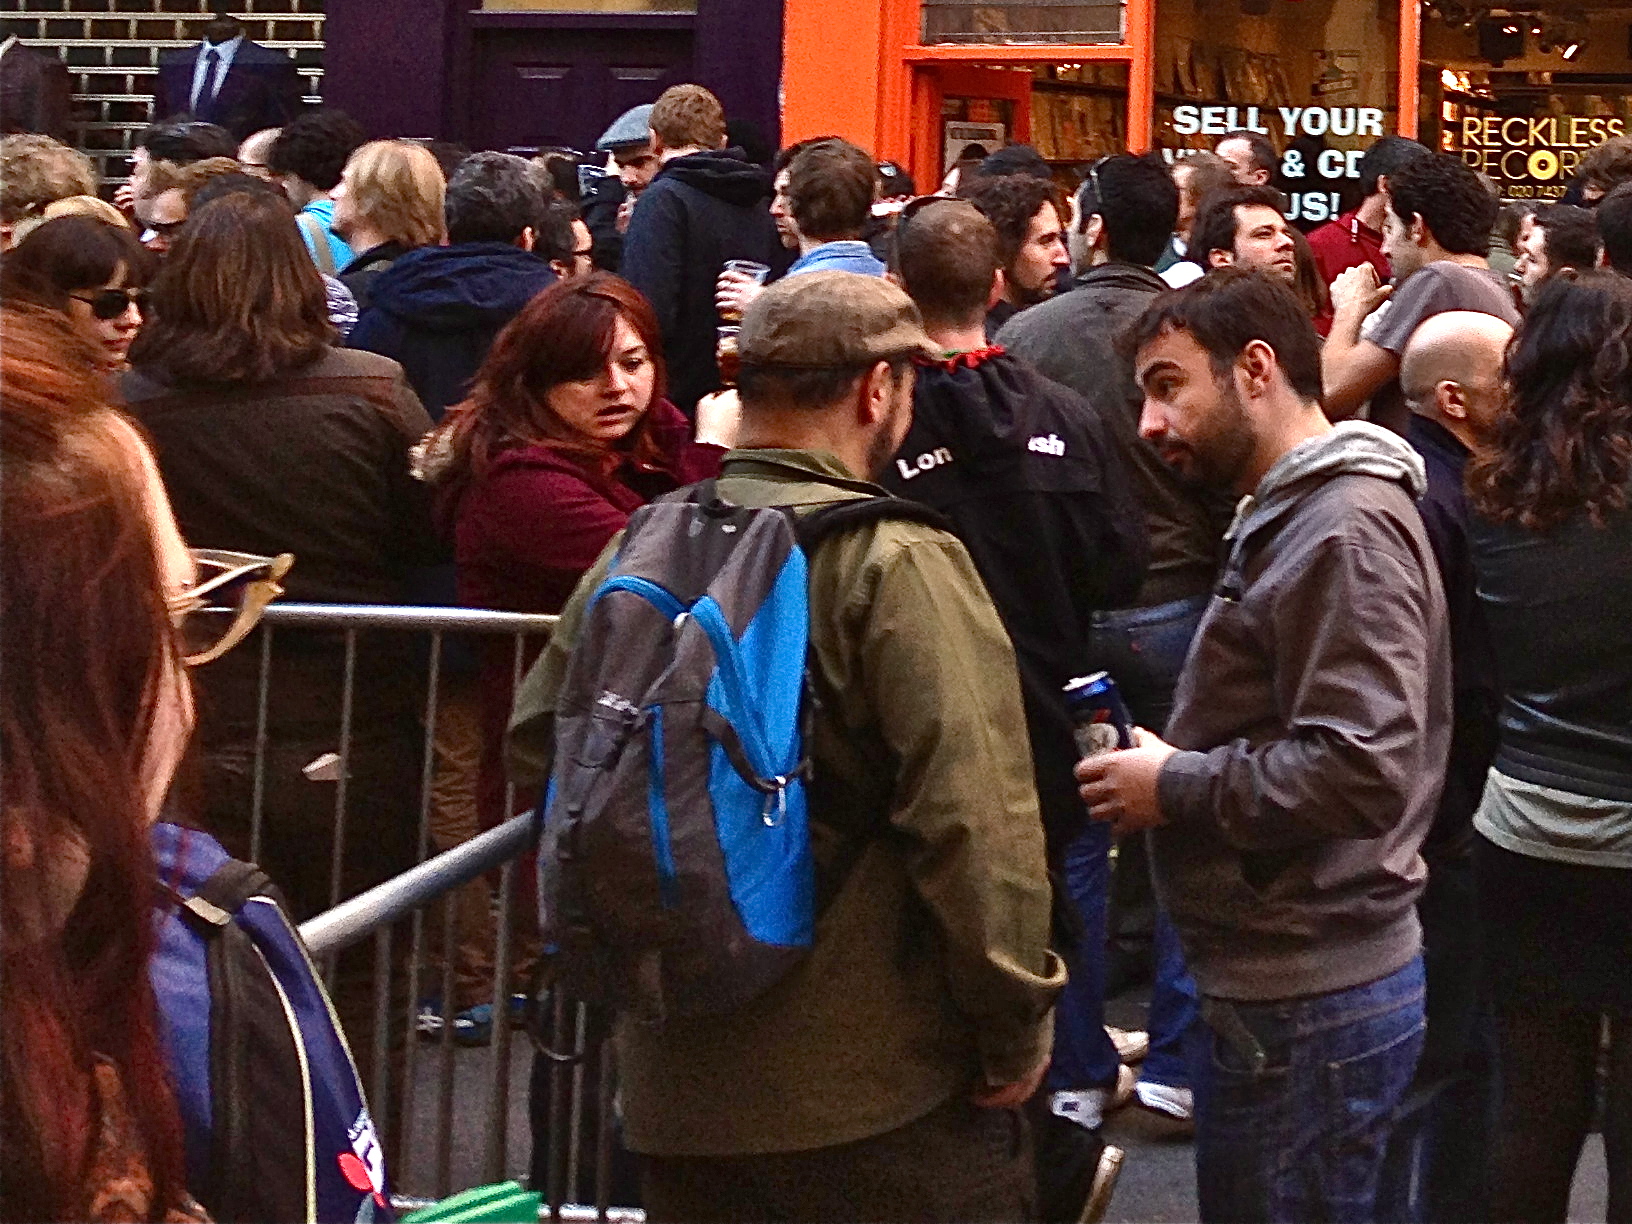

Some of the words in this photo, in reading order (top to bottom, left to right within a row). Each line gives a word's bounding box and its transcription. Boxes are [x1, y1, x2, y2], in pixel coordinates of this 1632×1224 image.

[1172, 105, 1269, 136] SELL
[1279, 106, 1384, 137] YOUR
[1462, 117, 1624, 148] RECKLESS
[1281, 149, 1306, 178] &
[896, 446, 954, 480] Lon
